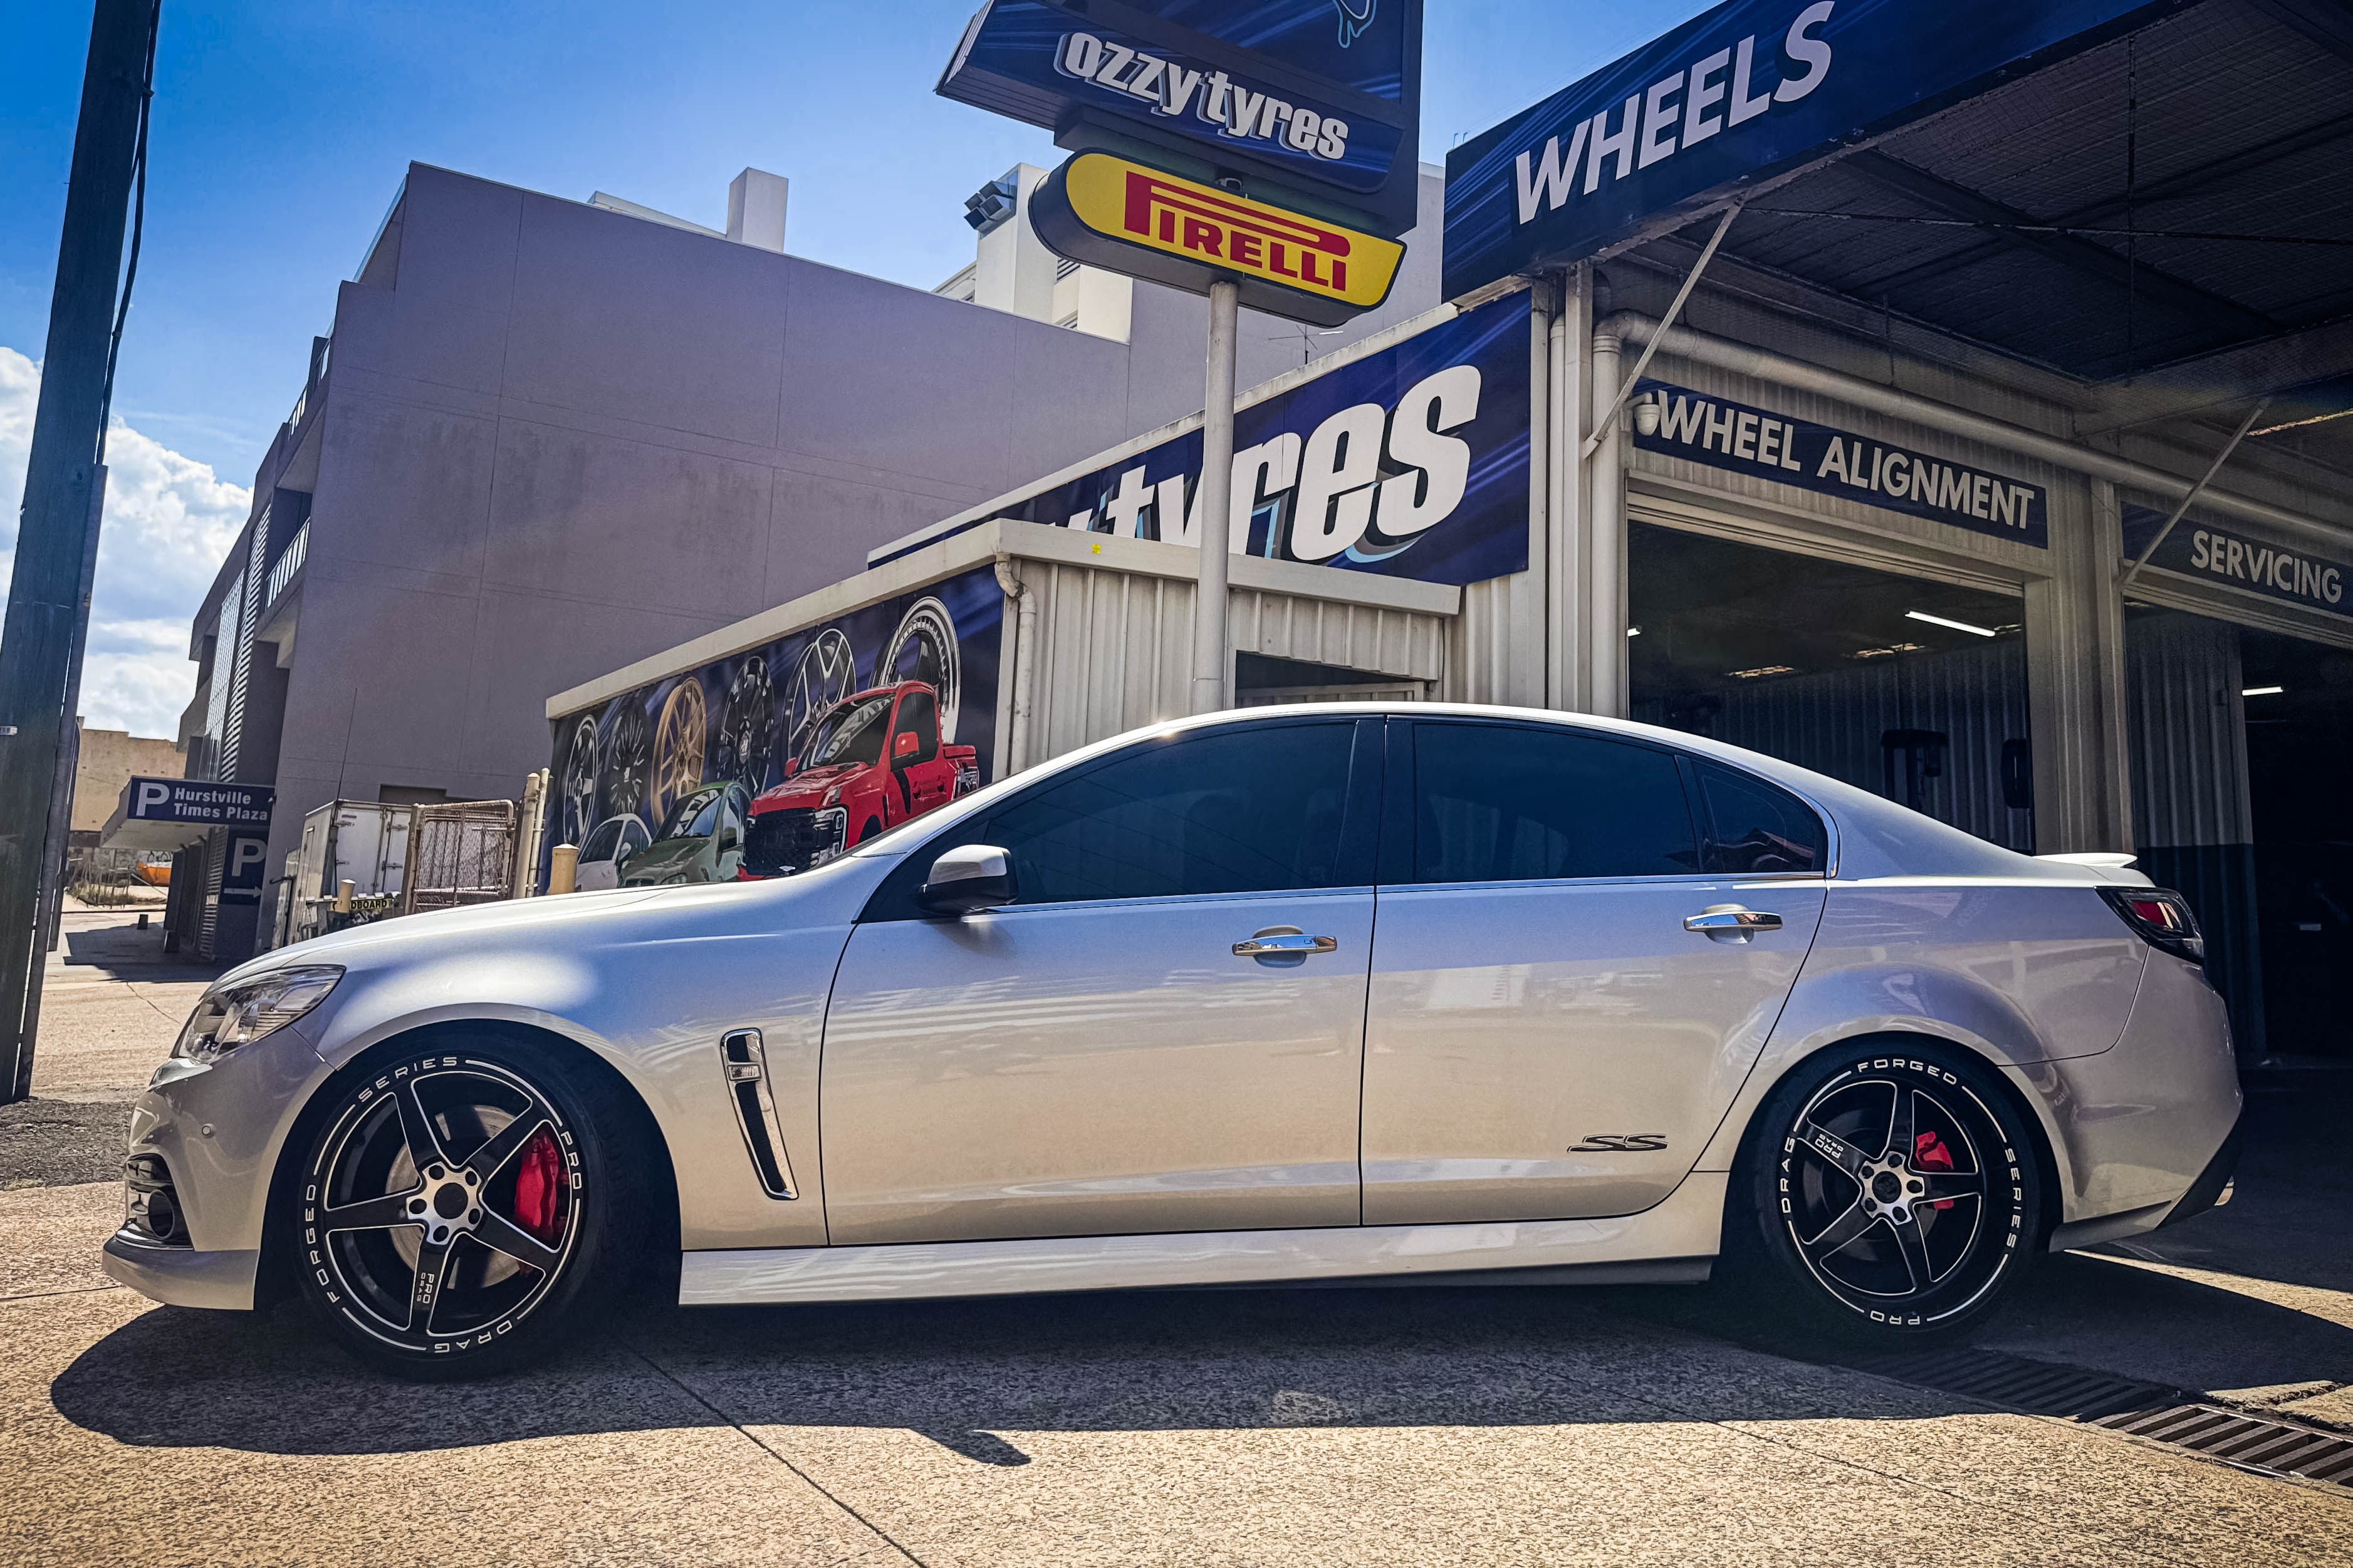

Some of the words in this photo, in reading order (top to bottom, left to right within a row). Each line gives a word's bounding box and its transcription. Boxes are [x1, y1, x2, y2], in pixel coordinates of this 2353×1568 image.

[1515, 1, 1835, 226] WHEELS
[1124, 170, 1351, 292] PIRELLI
[1657, 390, 1801, 472] WHEEL
[1817, 436, 2035, 529] ALIGNMENT
[2191, 529, 2342, 604] SERVICING
[135, 782, 170, 817] P
[174, 787, 251, 805] Hurstville
[174, 802, 221, 818] Times
[226, 806, 268, 821] Plaza
[231, 837, 267, 877] P
[358, 1056, 457, 1103] SERIES
[1857, 1058, 1958, 1086] FORGED
[560, 1129, 583, 1191] PRO
[1567, 1133, 1668, 1153] SS
[1814, 1138, 1842, 1159] PRO
[1779, 1138, 1797, 1214] DRAG
[2005, 1148, 2022, 1249] SERIES
[305, 1184, 340, 1304] FORGED
[416, 1272, 426, 1302] DRAG
[422, 1273, 435, 1304] PRO
[433, 1319, 513, 1354] DRAG
[1870, 1310, 1921, 1326] PRO
